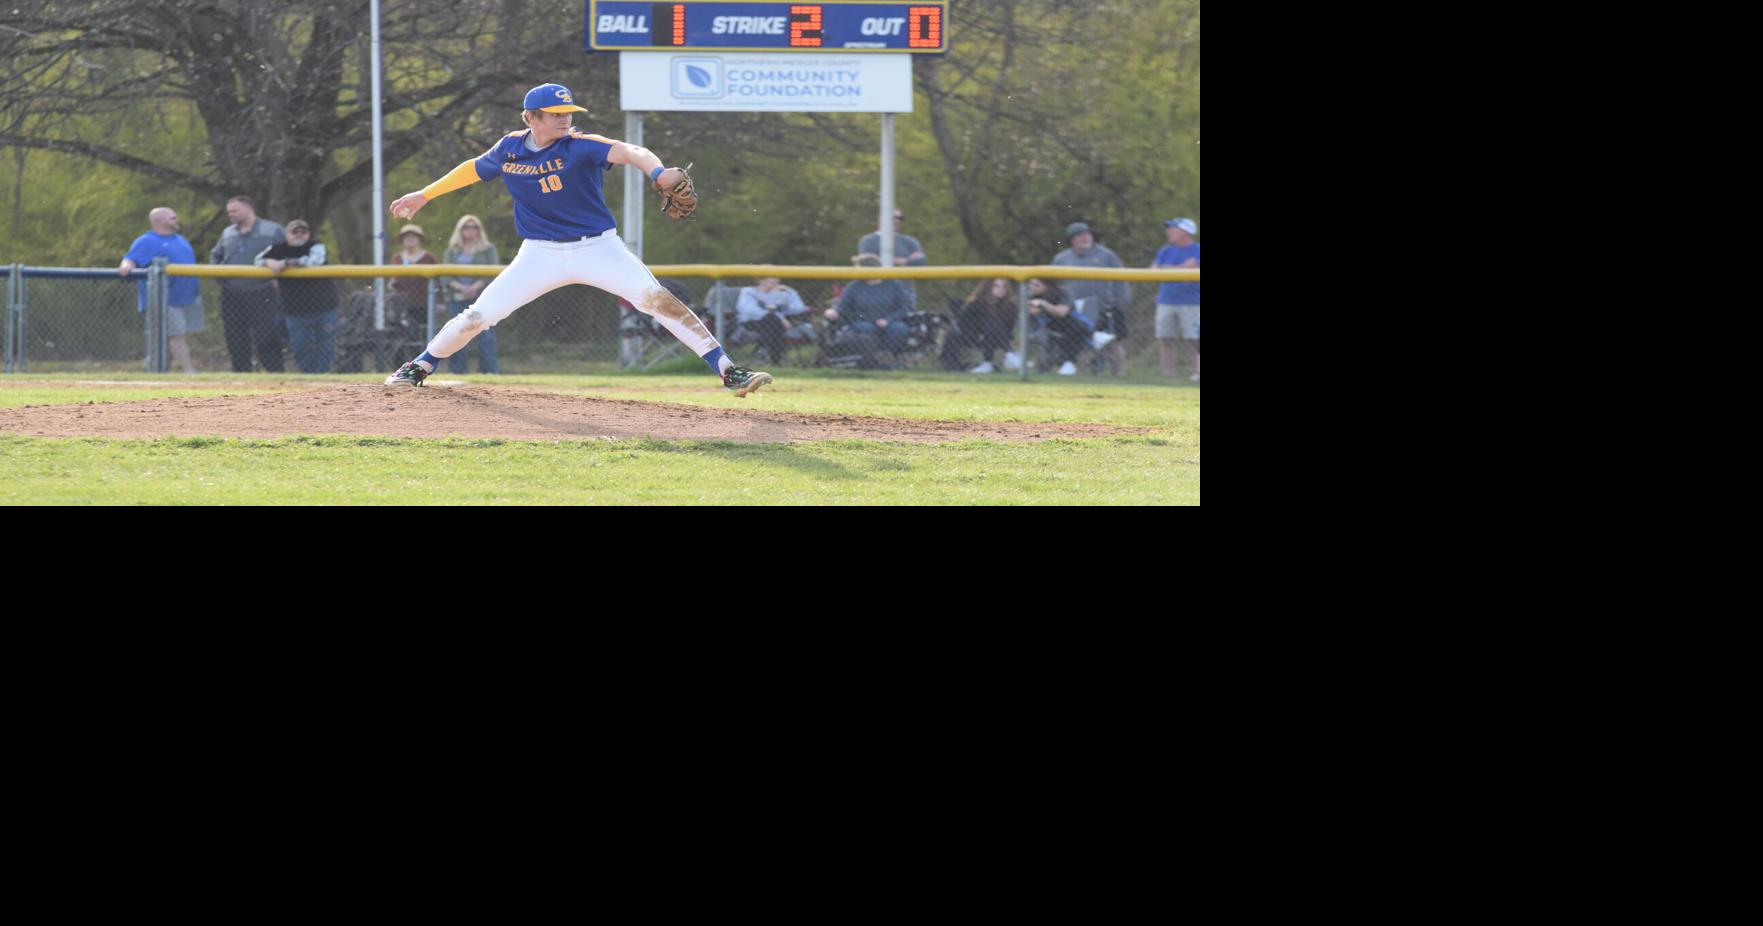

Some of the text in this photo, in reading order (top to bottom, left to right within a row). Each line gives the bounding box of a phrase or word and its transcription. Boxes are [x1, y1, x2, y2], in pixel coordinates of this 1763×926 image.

[597, 4, 941, 48] BALL 1 STRIKE 2 OUT 0
[727, 70, 860, 82] COMMUNITY
[727, 84, 861, 96] FOUNDATION
[502, 158, 565, 175] GREENLLE
[538, 174, 563, 193] 10
